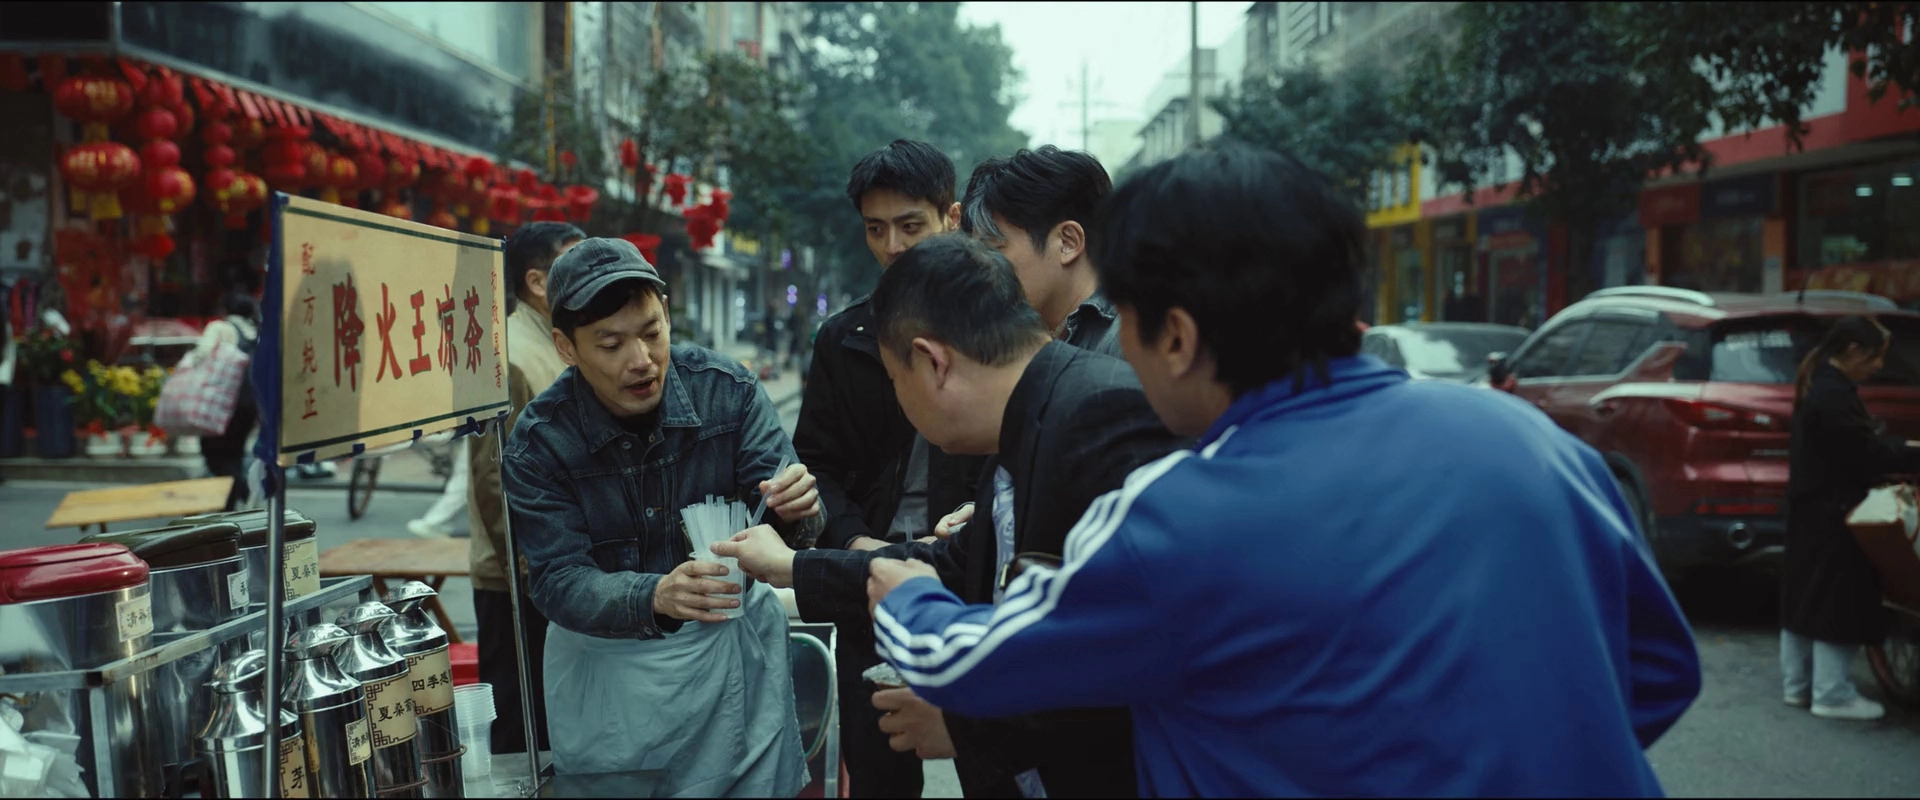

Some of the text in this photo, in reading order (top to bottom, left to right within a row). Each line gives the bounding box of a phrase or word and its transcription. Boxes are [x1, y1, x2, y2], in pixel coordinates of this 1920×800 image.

[301, 242, 318, 420] 配方纯正
[333, 272, 484, 392] 降火王凉茶
[412, 669, 452, 692] 四季感
